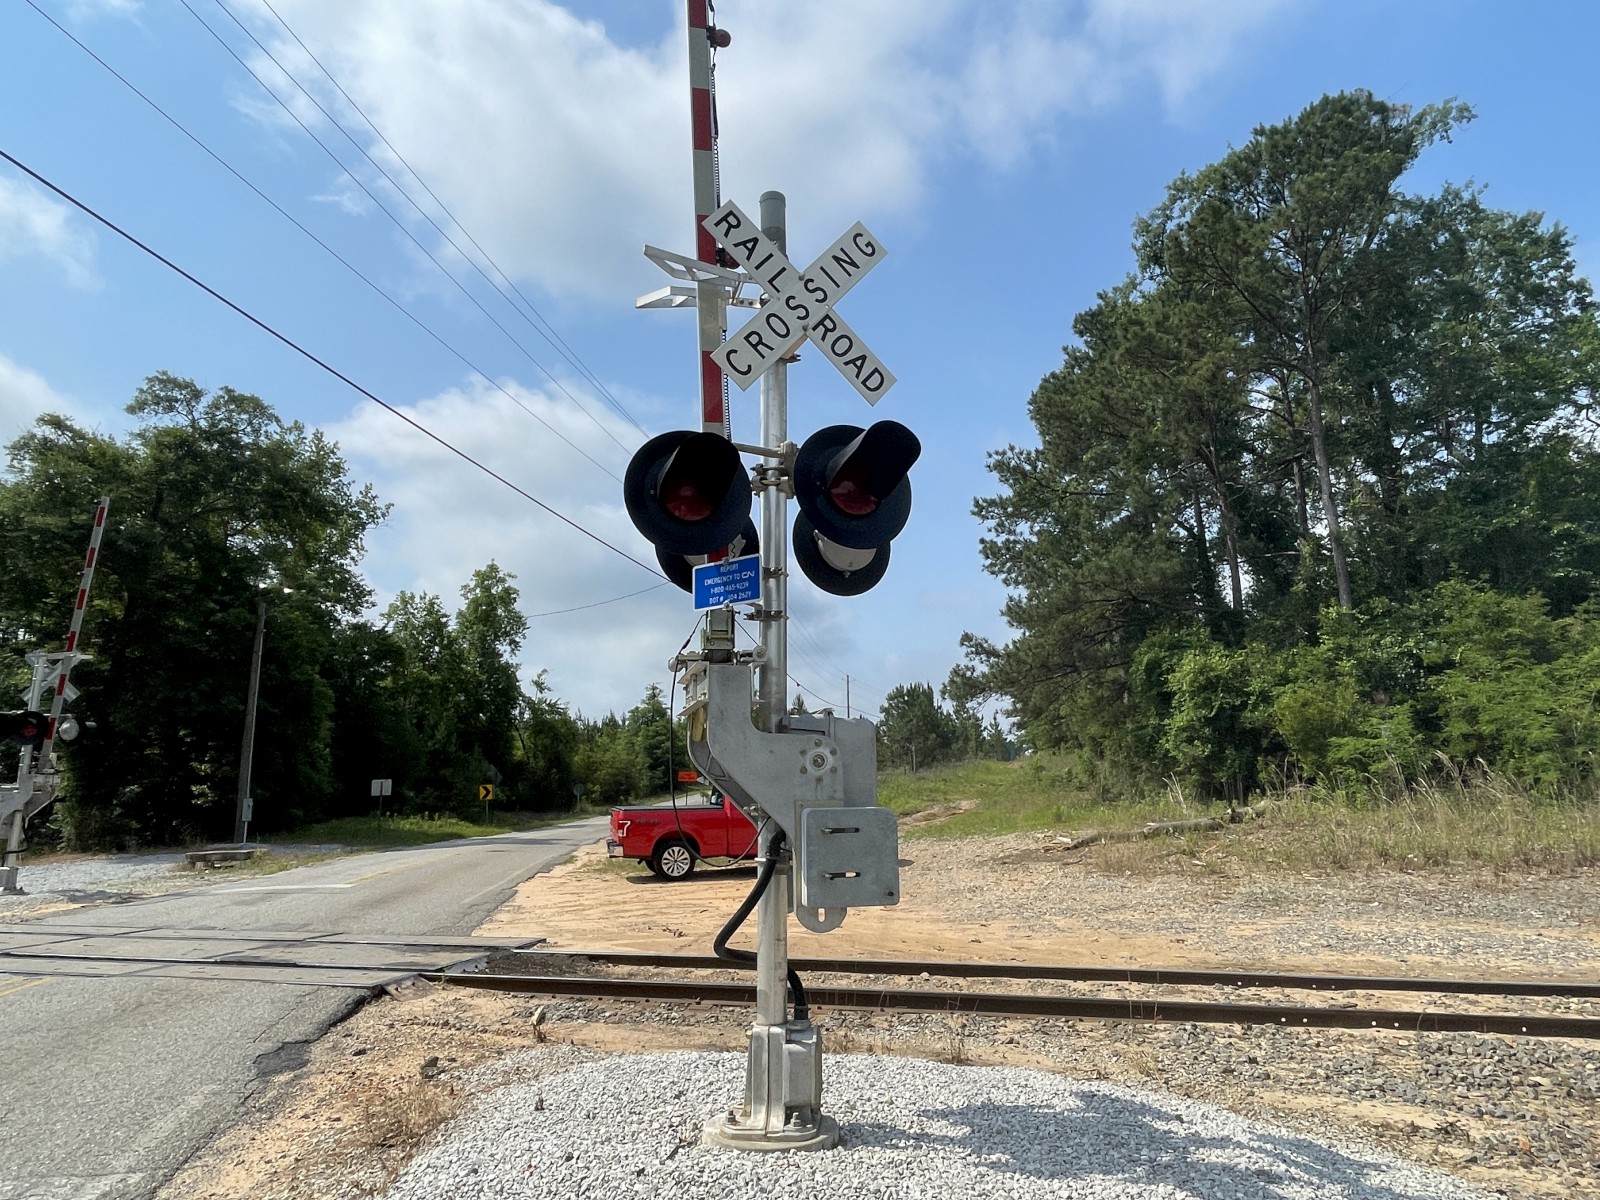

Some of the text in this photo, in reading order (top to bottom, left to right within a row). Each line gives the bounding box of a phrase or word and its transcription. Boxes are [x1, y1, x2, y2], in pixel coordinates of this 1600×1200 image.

[713, 209, 885, 393] RAIL ROAD
[725, 232, 876, 376] CROSSING
[720, 564, 738, 573] REPORT
[704, 576, 732, 586] EMERGENCY
[741, 570, 755, 579] CN
[709, 597, 719, 605] DOT
